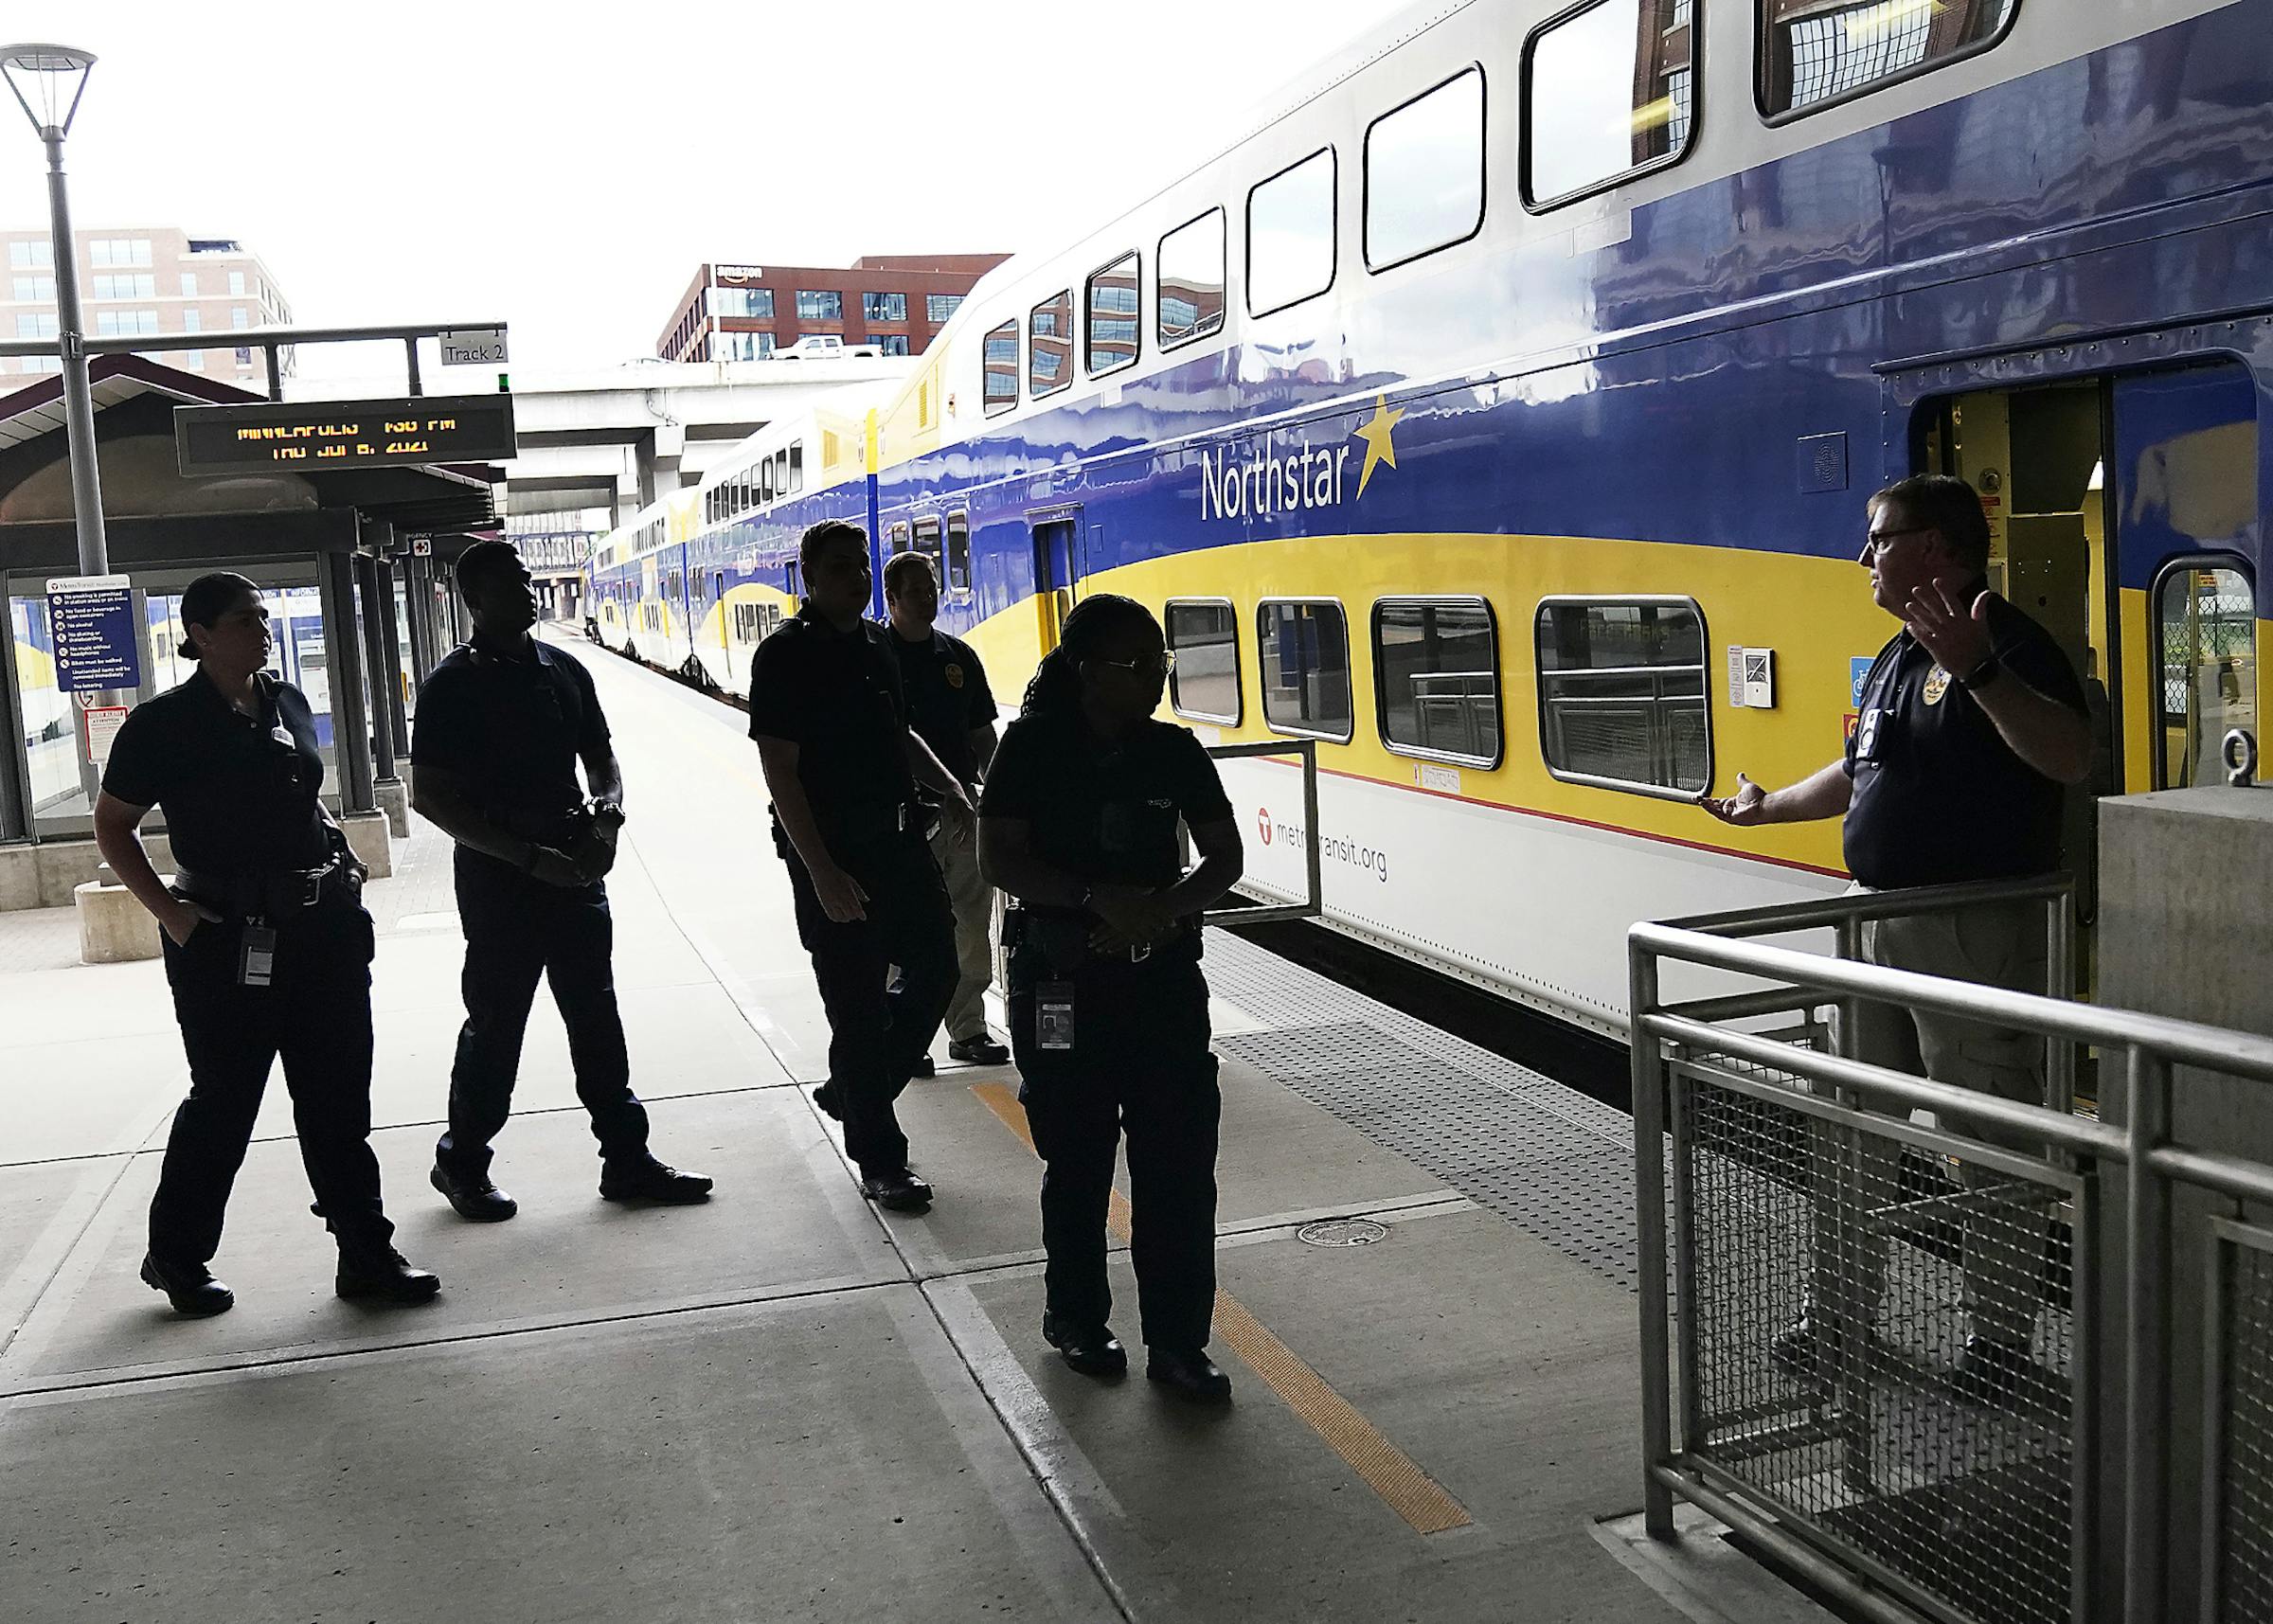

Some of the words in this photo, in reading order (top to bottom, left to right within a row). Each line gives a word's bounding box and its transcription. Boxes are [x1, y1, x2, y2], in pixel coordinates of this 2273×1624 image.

[717, 266, 763, 278] amazon
[445, 345, 489, 361] Track
[493, 344, 504, 359] 2
[1201, 431, 1350, 521] Northstar
[1277, 822, 1387, 883] metrransit.org
